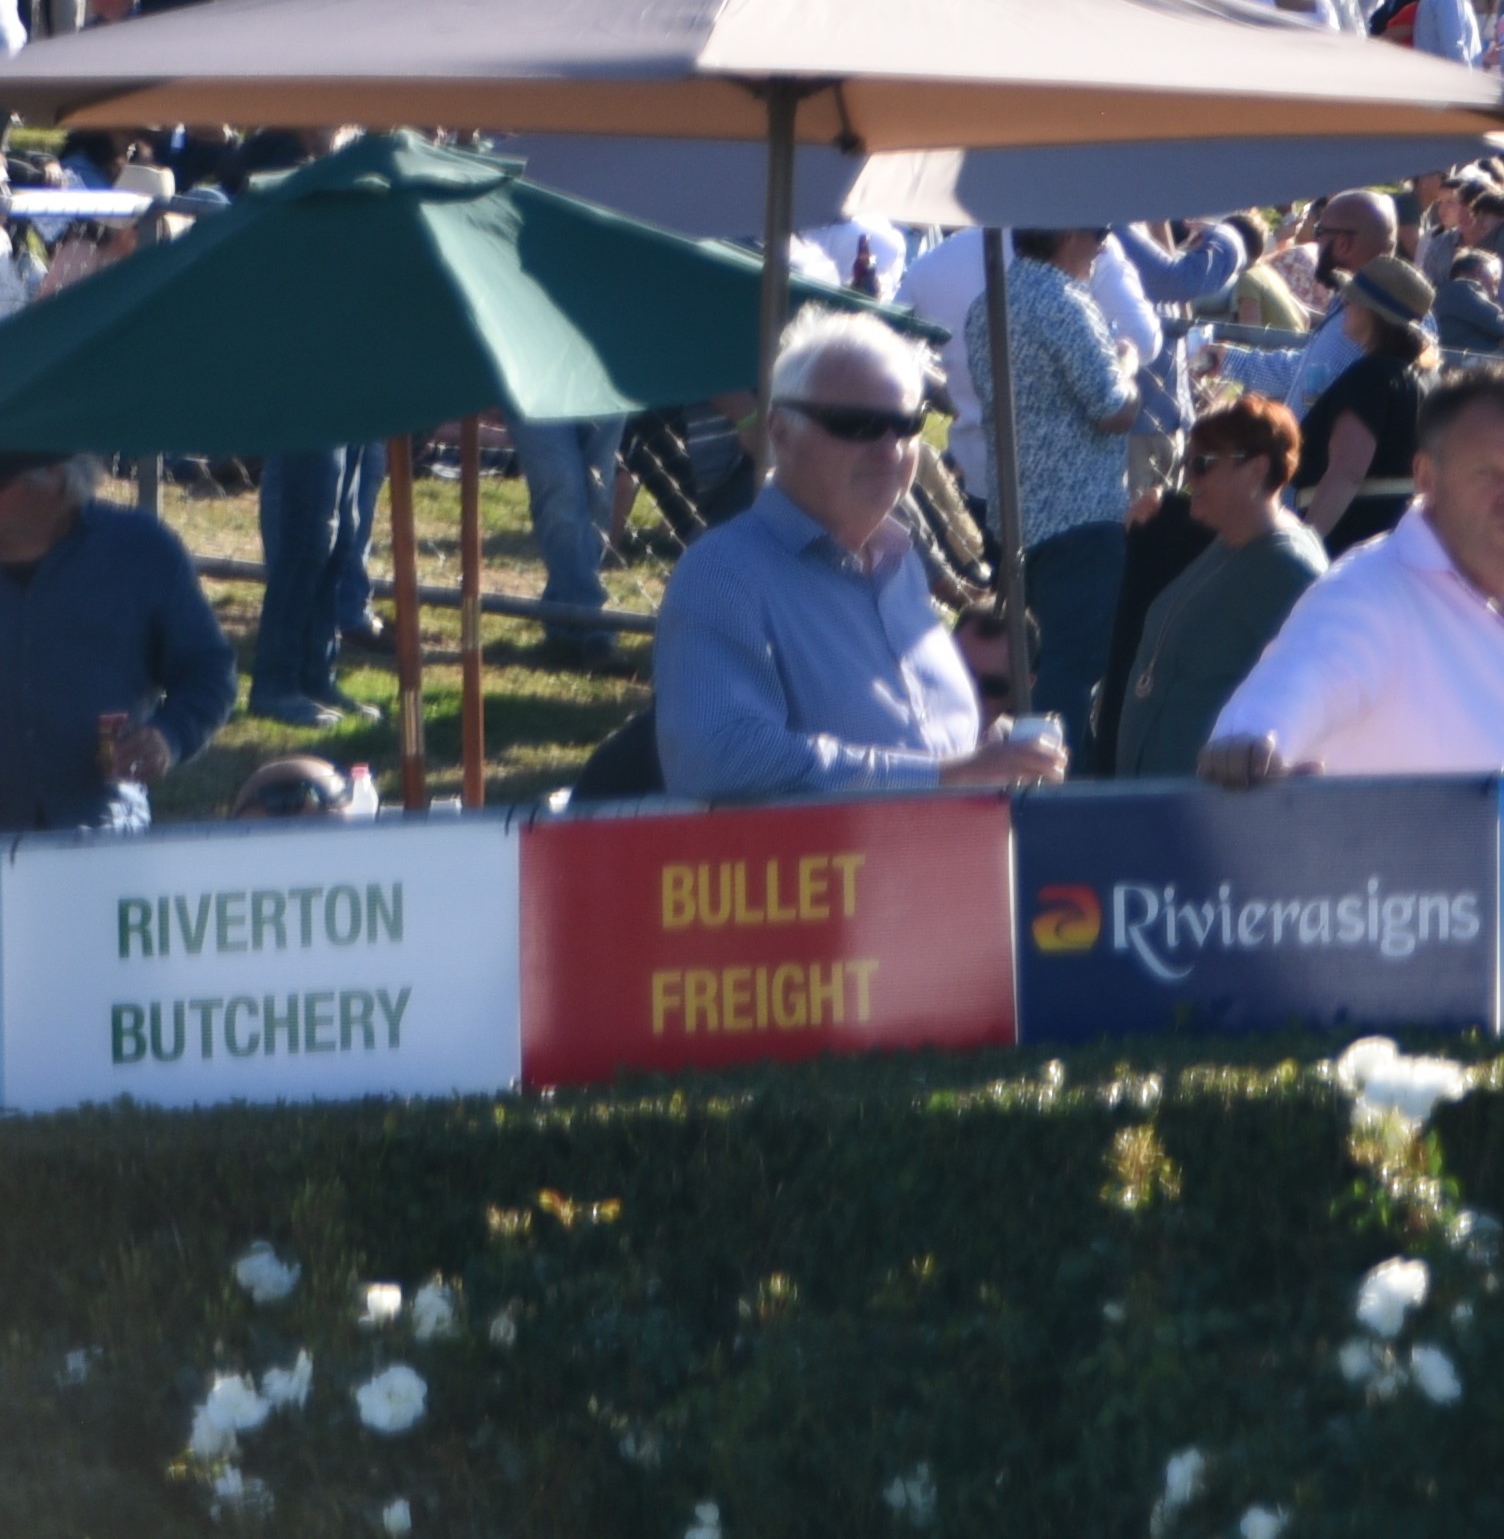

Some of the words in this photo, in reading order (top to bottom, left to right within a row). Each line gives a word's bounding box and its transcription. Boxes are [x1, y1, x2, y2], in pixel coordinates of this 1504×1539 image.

[117, 881, 404, 959] RIVERTON
[661, 853, 866, 930] BULLET
[1112, 876, 1481, 979] Rivierasigns
[110, 986, 412, 1065] BUTCHERY
[651, 959, 880, 1035] FREIGHT
